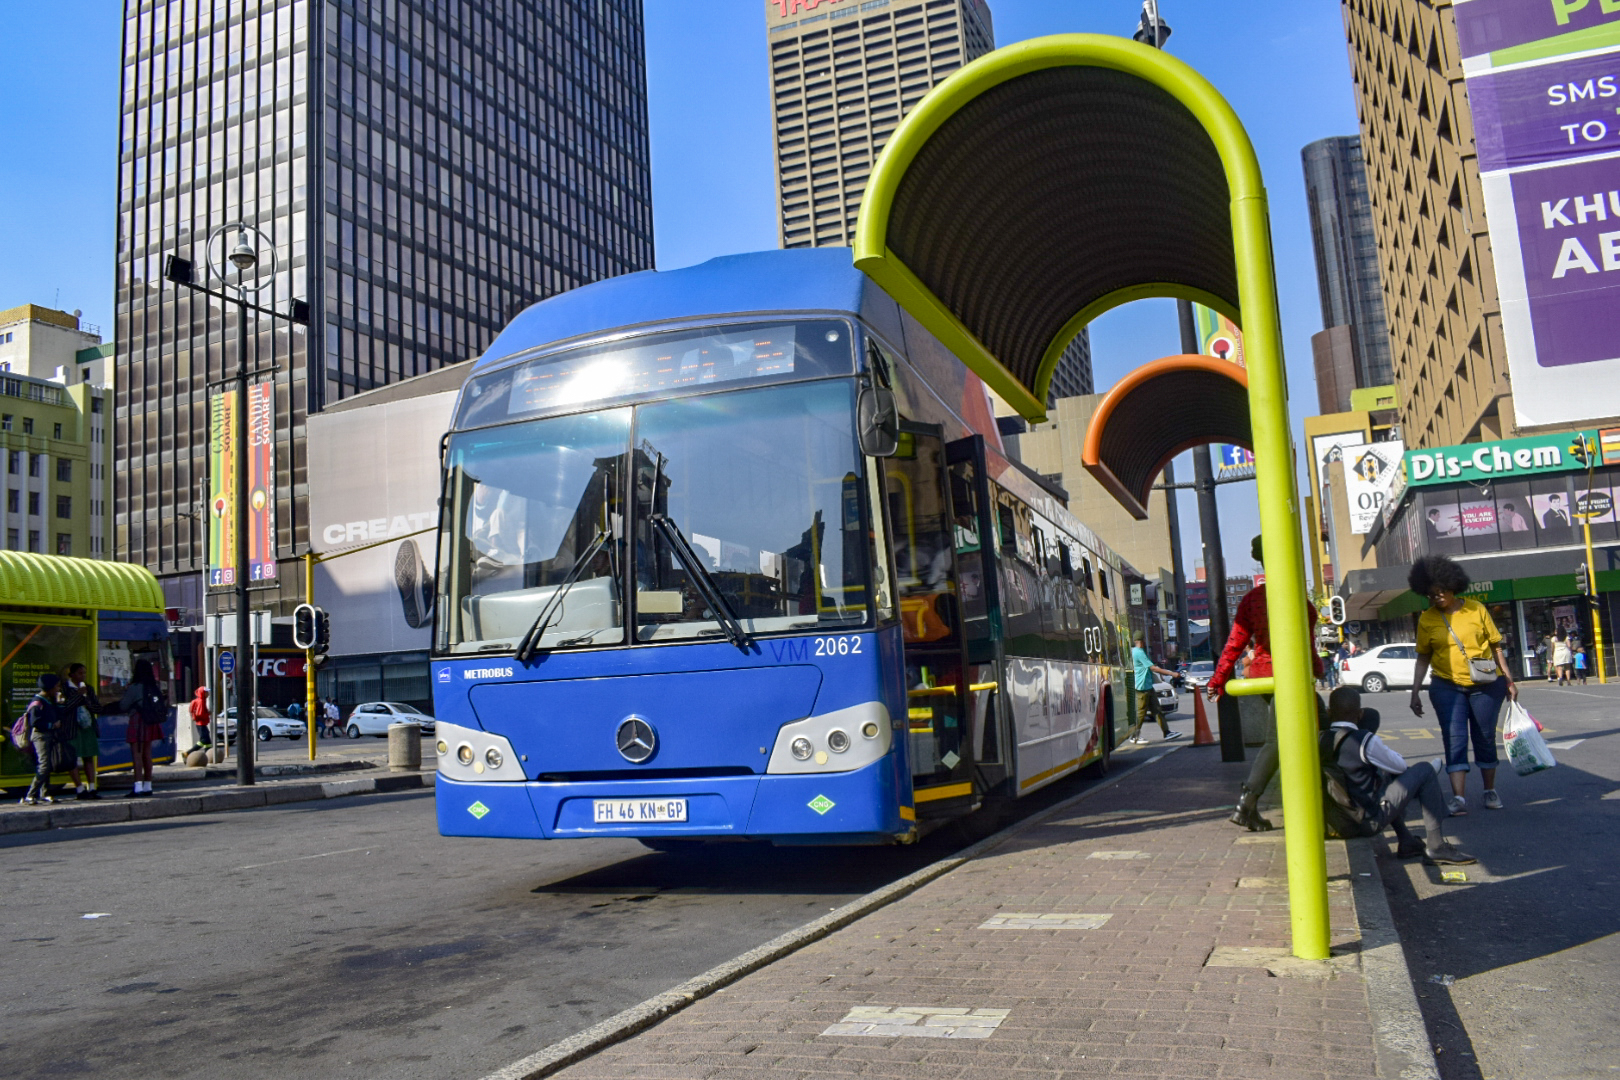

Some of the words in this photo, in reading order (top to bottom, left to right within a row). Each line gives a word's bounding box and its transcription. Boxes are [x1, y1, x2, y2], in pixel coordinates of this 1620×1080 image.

[1547, 76, 1617, 106] SMS
[1560, 120, 1607, 145] TO
[212, 396, 225, 454] GANDHI
[250, 387, 263, 447] GANDHI
[262, 396, 271, 445] SQUARE
[1411, 445, 1562, 480] Dis-Chem
[1464, 516, 1494, 524] EVICTED!
[769, 638, 808, 662] VM
[814, 635, 862, 656] 2062
[250, 658, 287, 677] KFC
[464, 667, 513, 679] METROBUS
[598, 803, 613, 820] FH
[619, 802, 634, 819] 46
[640, 802, 656, 819] KN
[667, 802, 683, 818] GP
